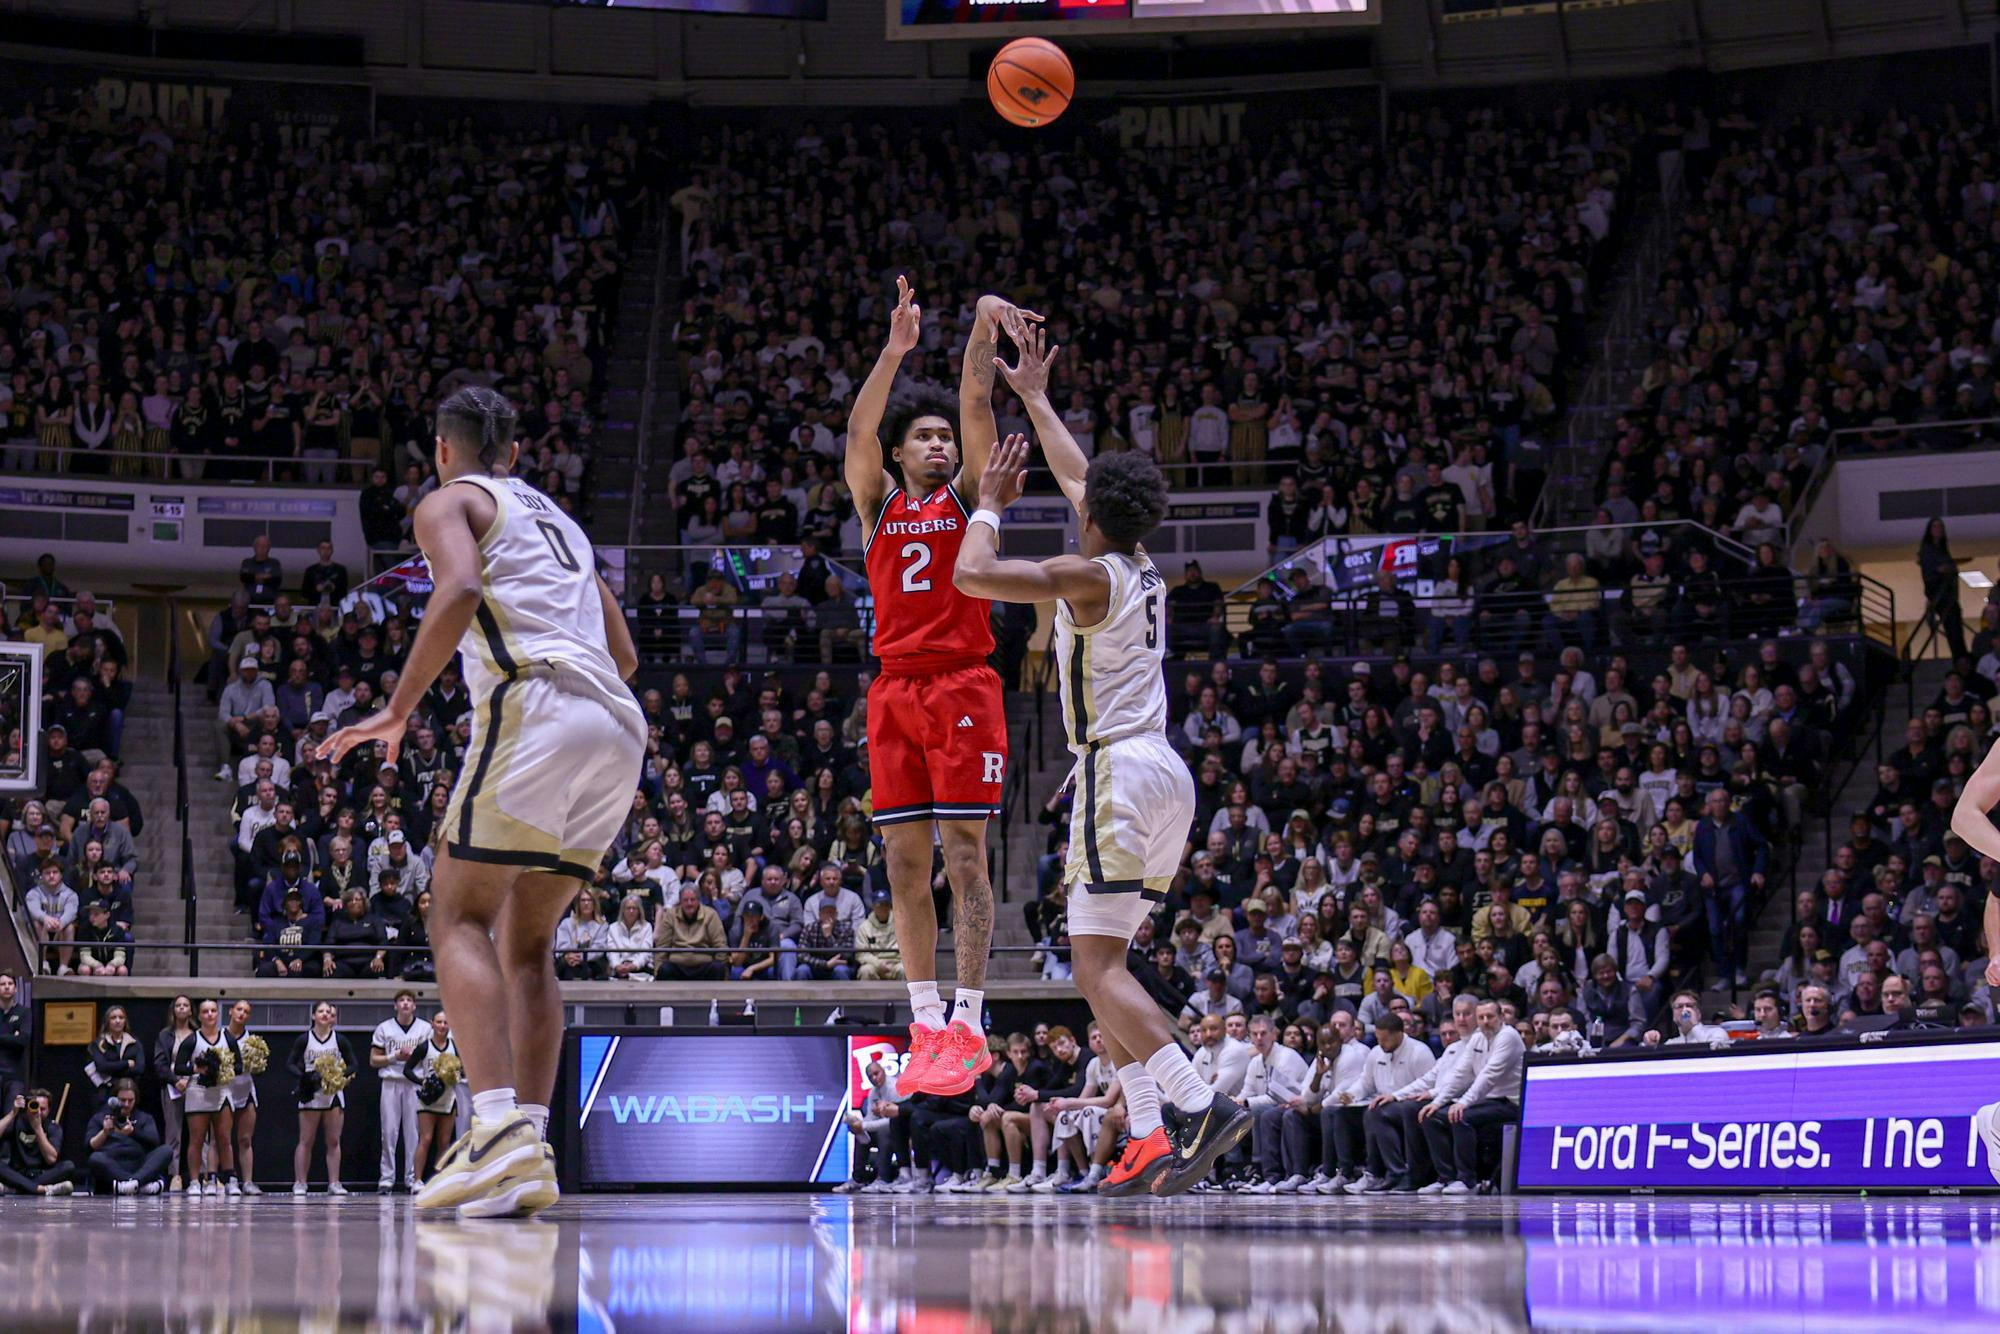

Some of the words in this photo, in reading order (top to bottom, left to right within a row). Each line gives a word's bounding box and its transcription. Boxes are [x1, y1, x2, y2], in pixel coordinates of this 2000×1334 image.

[94, 77, 233, 131] PAINT
[1119, 102, 1247, 148] PAINT
[153, 505, 182, 516] 14-15
[512, 491, 553, 513] COX
[535, 518, 582, 573] 0
[882, 517, 958, 536] UTGERS
[900, 541, 932, 593] 2
[1145, 595, 1158, 649] 5
[981, 751, 1005, 783] R
[1551, 1123, 1638, 1170] Ford
